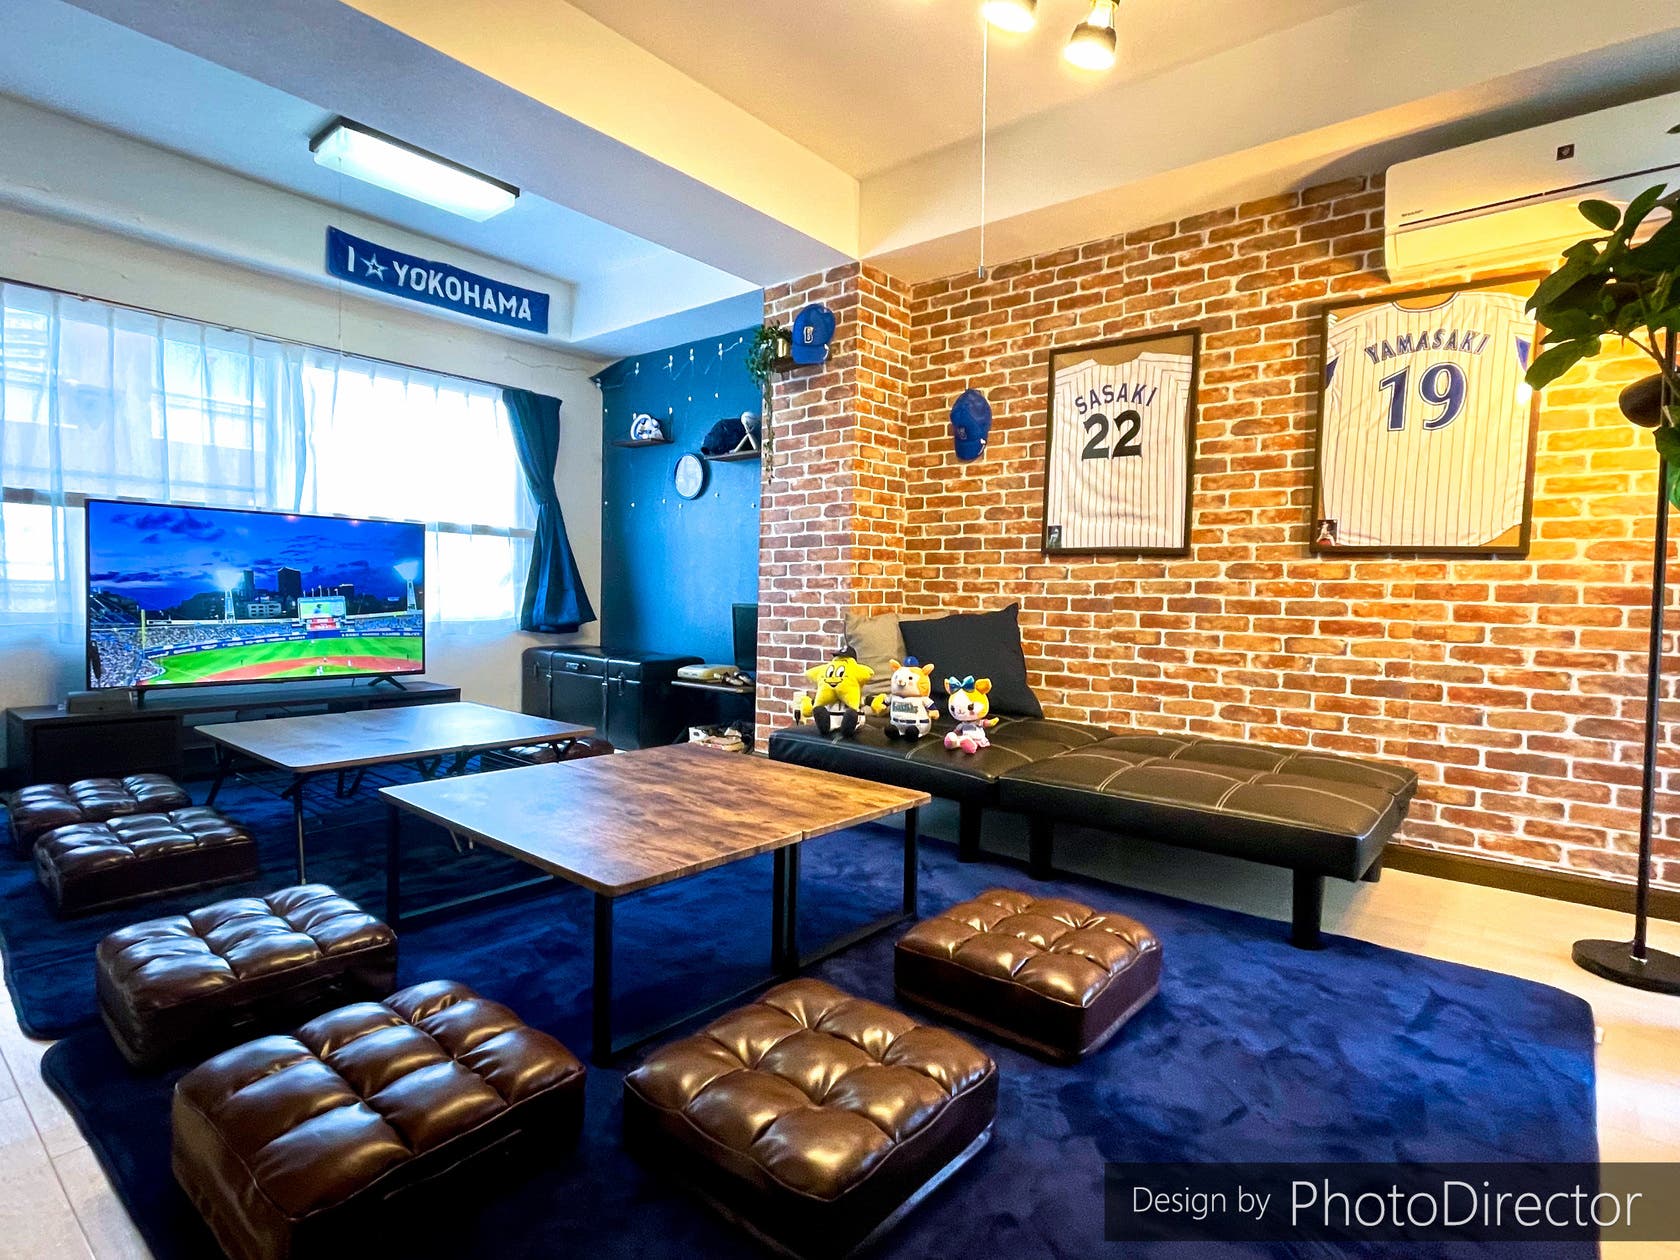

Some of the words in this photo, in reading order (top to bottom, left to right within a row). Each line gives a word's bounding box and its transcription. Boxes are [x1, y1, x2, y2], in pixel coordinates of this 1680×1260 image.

[347, 246, 355, 272] I
[392, 261, 532, 321] YOKOHAMA
[1364, 328, 1490, 365] YAMASAKI
[1075, 383, 1158, 415] SASAKI
[1379, 362, 1468, 432] 19
[1081, 409, 1143, 461] 22
